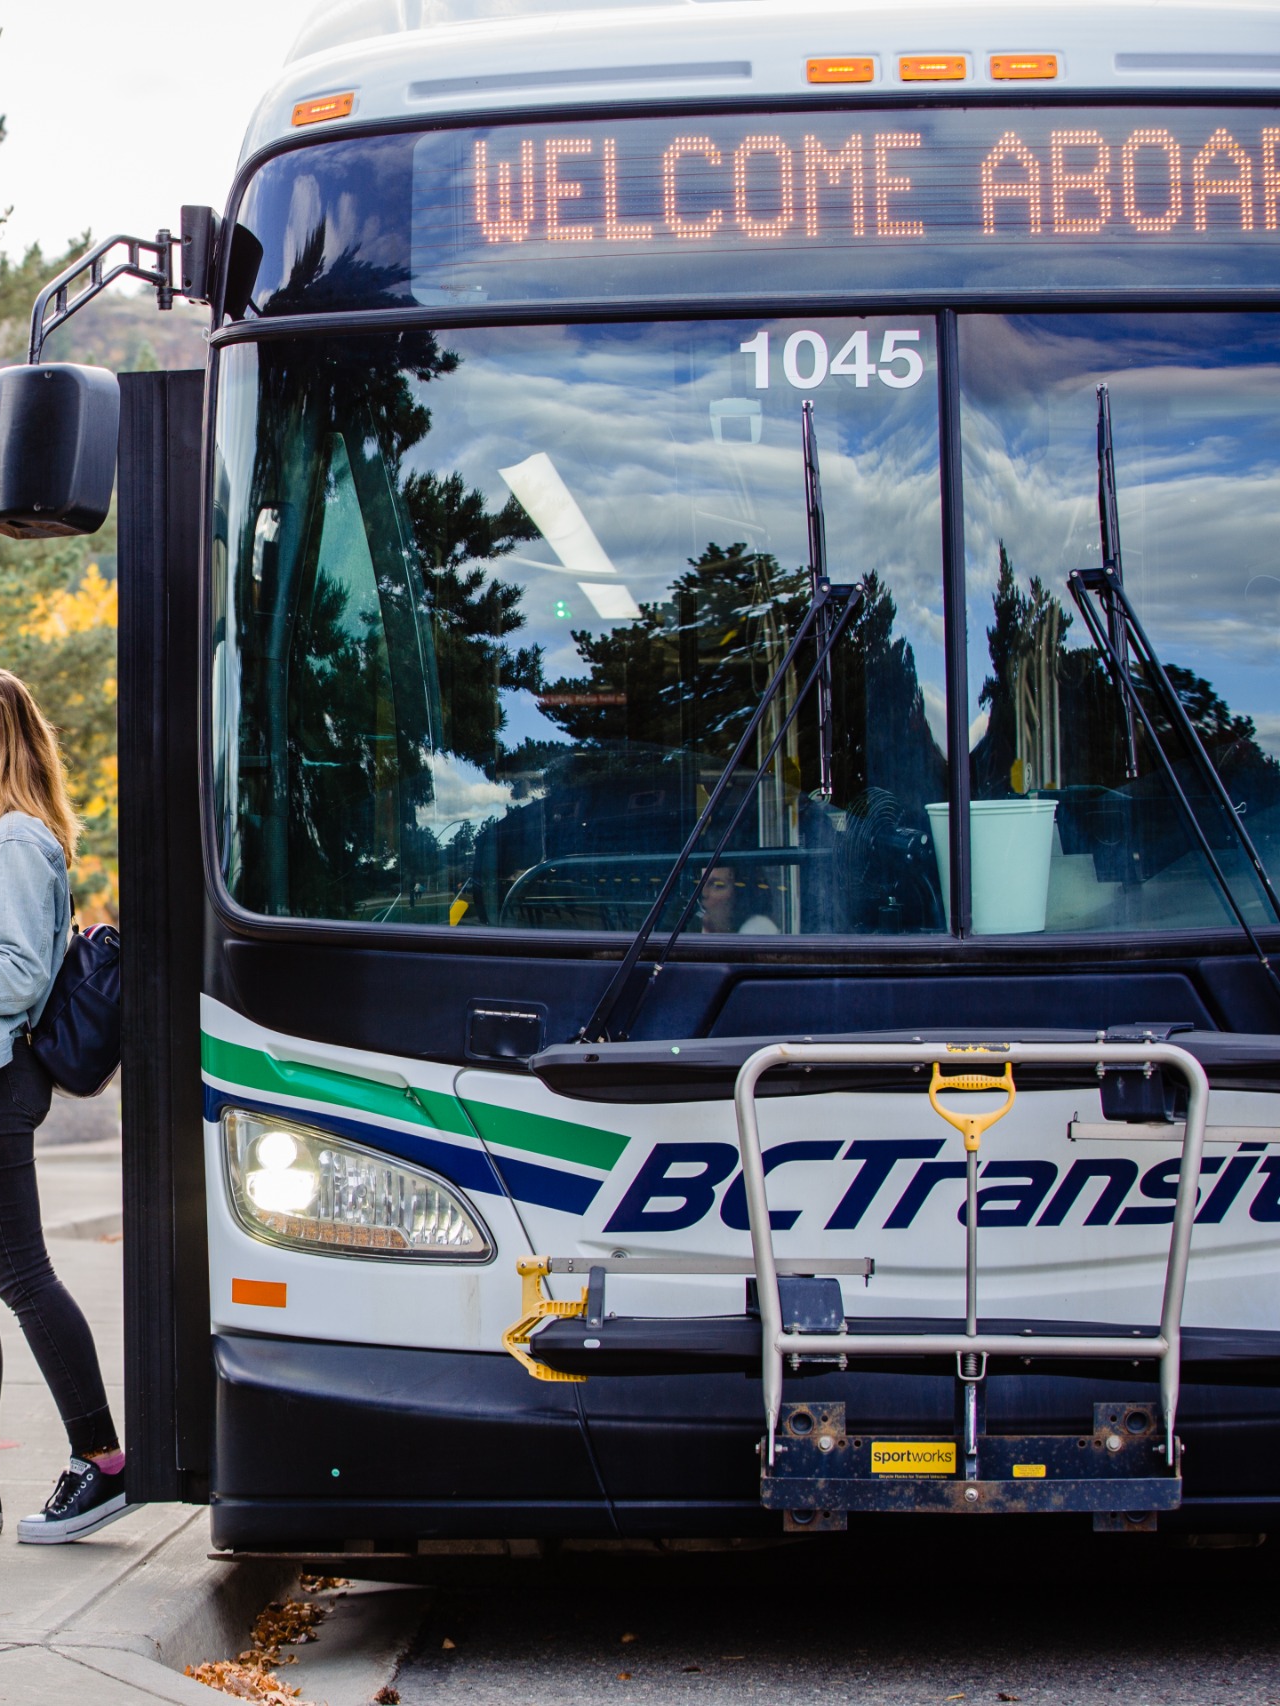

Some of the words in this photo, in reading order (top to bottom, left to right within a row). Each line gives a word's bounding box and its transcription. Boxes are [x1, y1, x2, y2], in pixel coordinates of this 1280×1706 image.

[475, 133, 924, 242] WELCOME
[740, 330, 924, 389] 1045
[873, 1449, 952, 1464] sportworks
